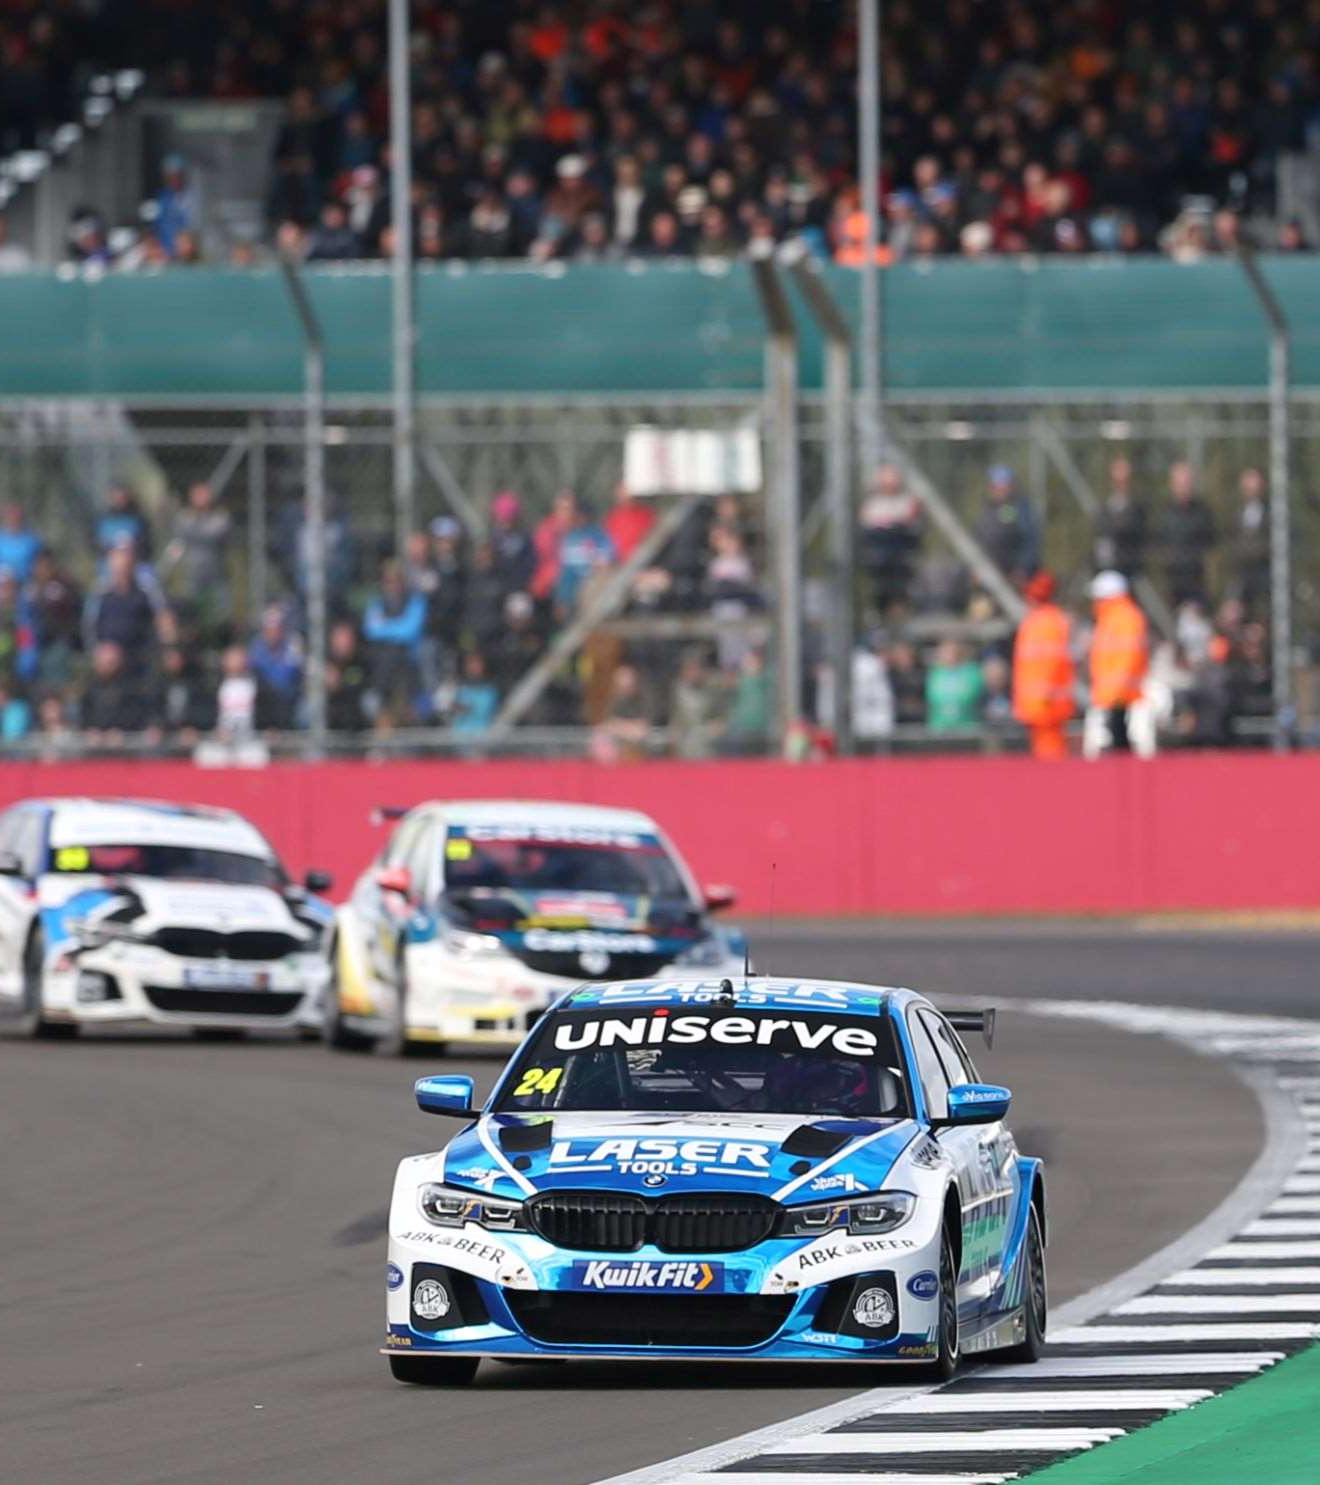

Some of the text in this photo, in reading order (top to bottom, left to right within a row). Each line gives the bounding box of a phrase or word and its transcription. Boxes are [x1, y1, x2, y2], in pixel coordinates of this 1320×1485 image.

[513, 1068, 563, 1096] 24
[550, 1138, 771, 1167] LASER
[617, 1161, 698, 1176] TOOLS
[398, 1231, 506, 1264] ABK BEER
[798, 1239, 918, 1269] ABK BEER
